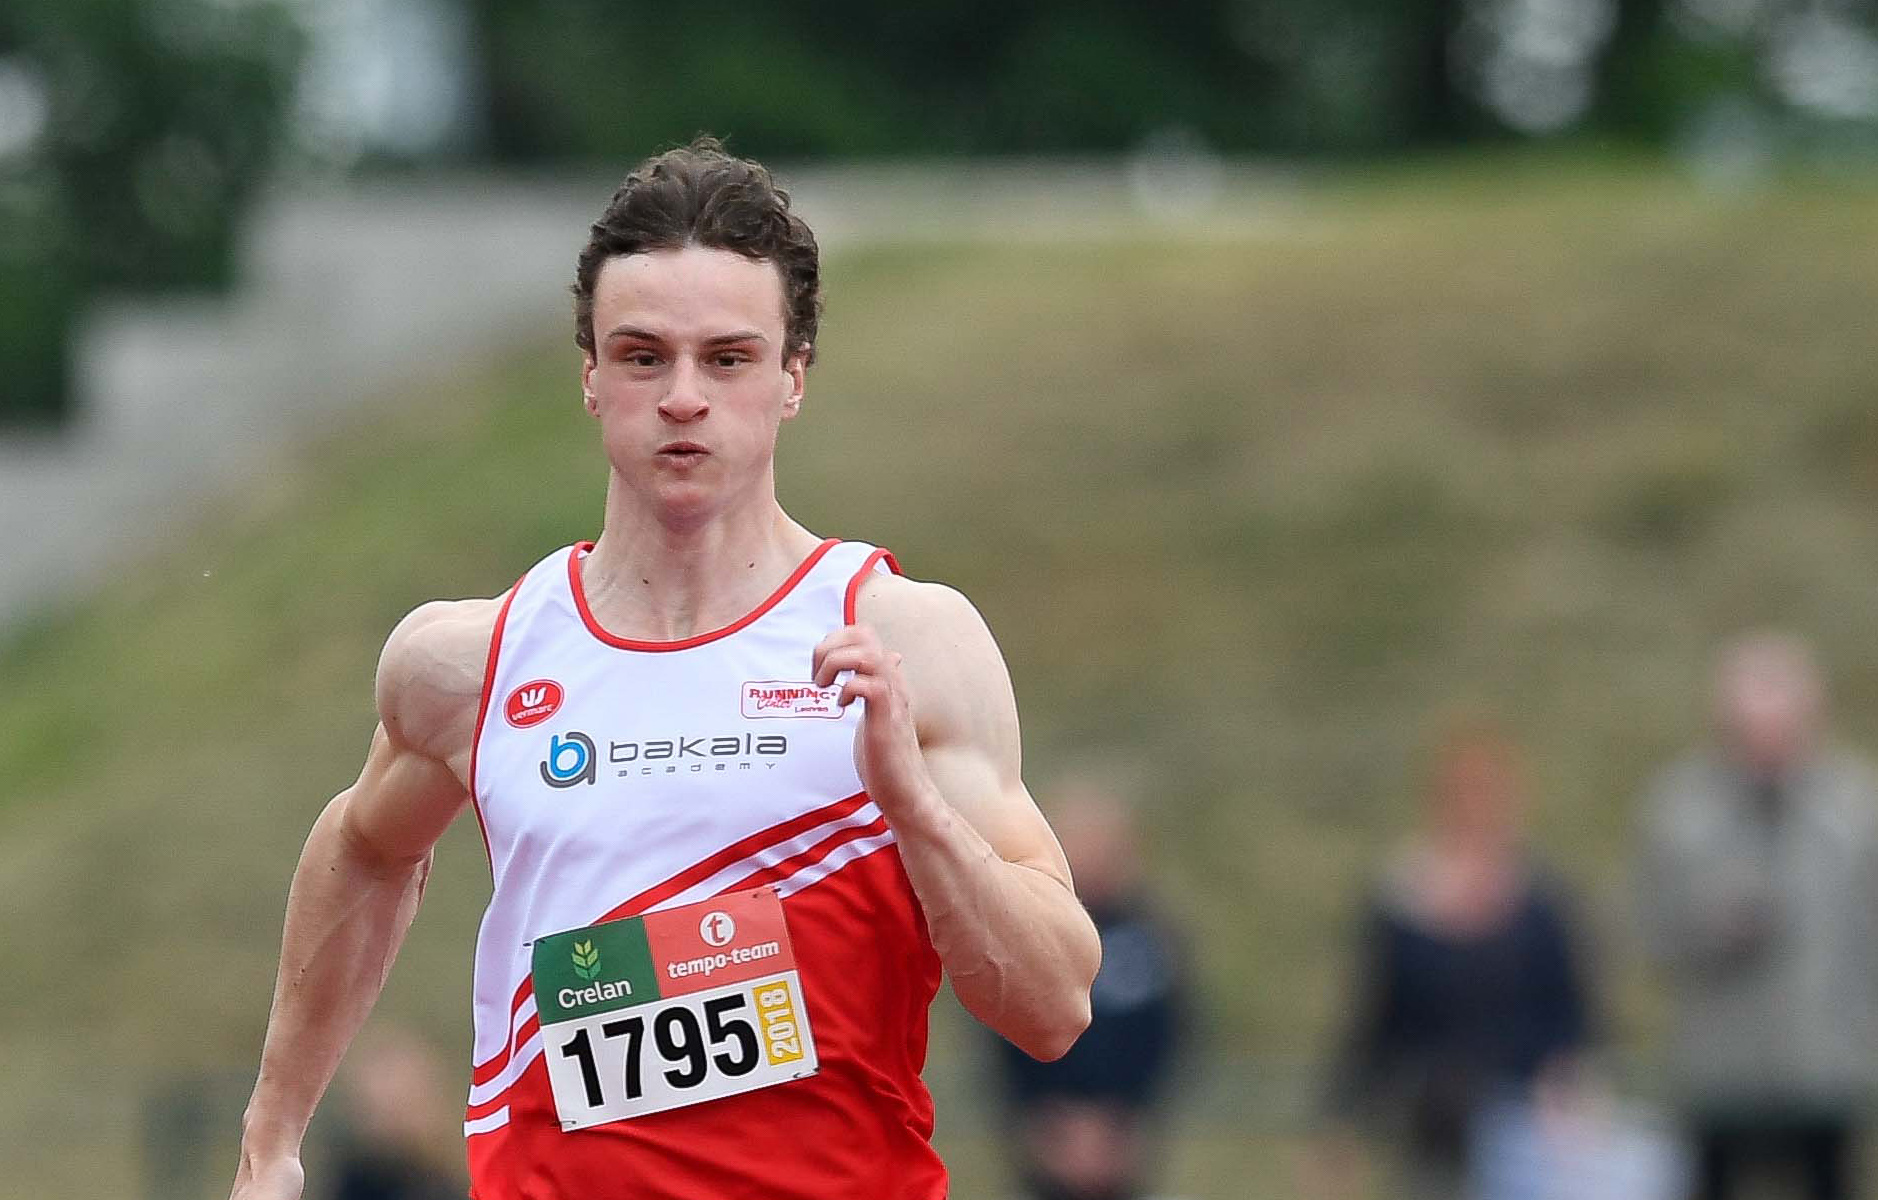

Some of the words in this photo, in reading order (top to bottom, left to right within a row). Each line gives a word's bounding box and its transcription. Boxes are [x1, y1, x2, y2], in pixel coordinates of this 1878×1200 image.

[610, 733, 787, 763] bakala
[617, 762, 776, 777] academy
[667, 940, 780, 979] tempo-team
[558, 979, 632, 1009] Crelan
[761, 987, 800, 1057] 2018
[561, 993, 760, 1108] 1795
